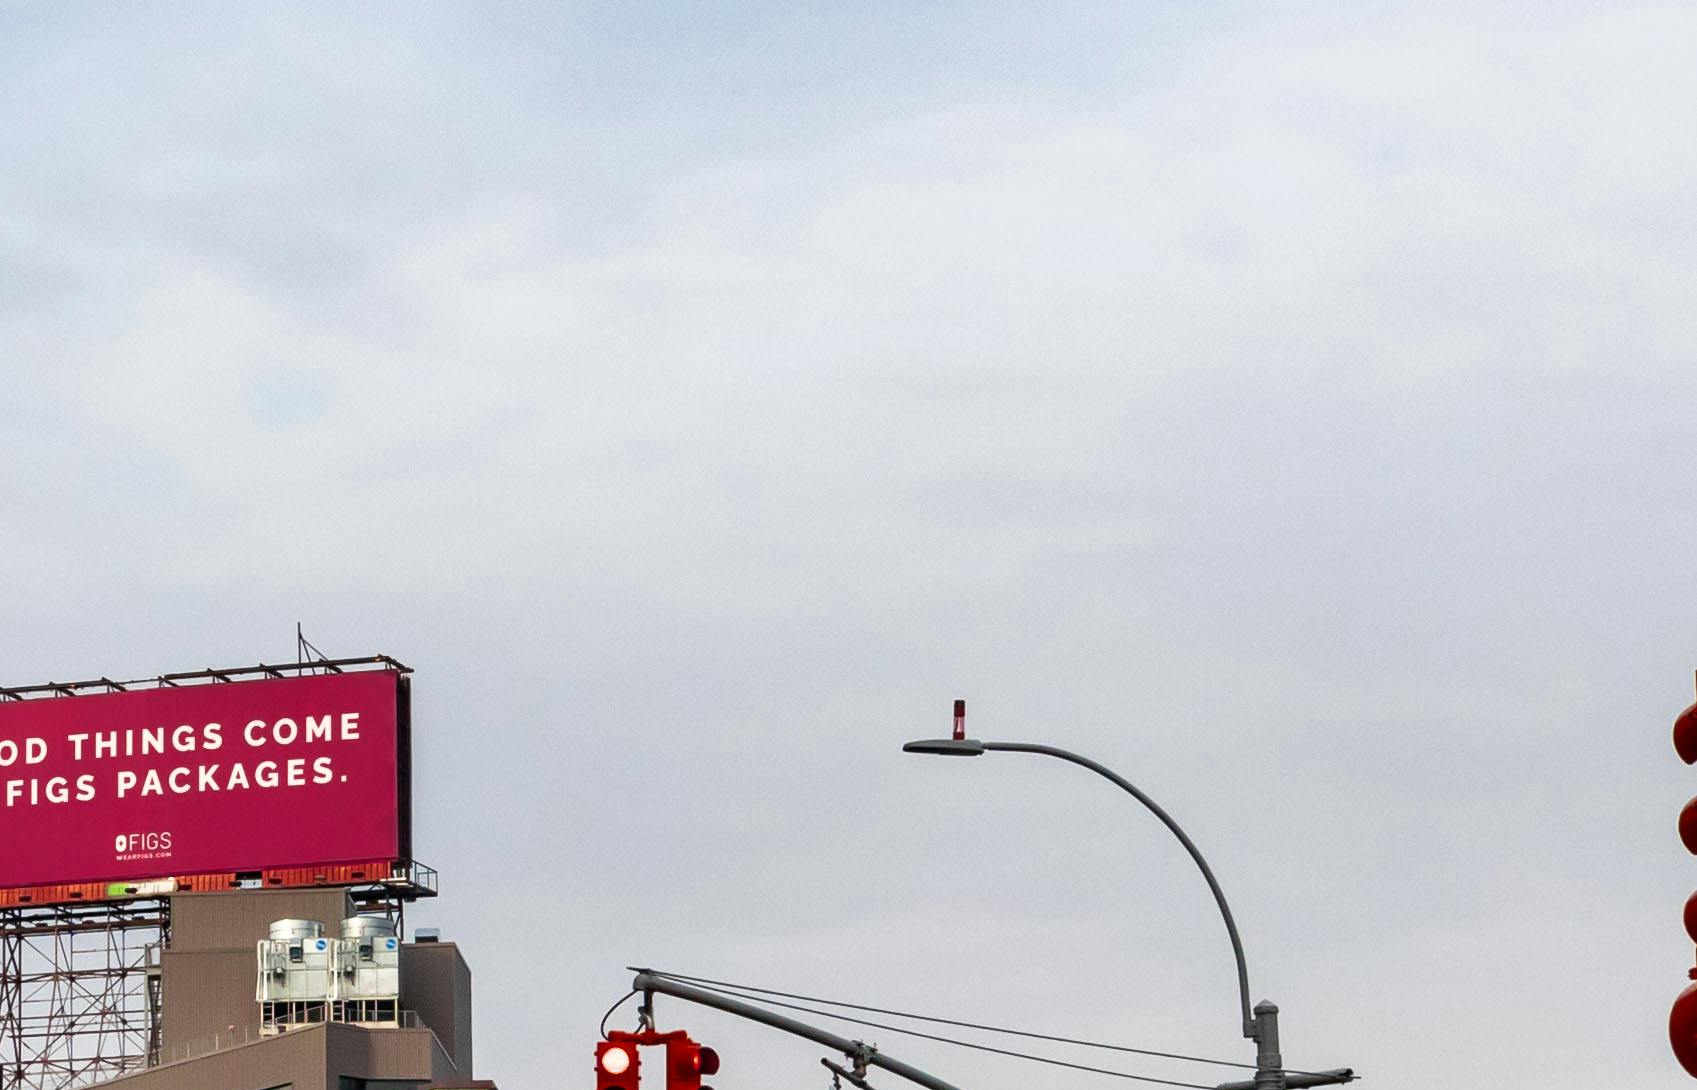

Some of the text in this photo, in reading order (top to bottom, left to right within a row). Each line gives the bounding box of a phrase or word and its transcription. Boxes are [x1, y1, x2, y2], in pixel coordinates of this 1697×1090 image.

[67, 722, 223, 761] THINGS
[243, 712, 360, 747] COME
[6, 774, 96, 807] FIGS
[117, 756, 348, 798] PACKAGES.
[129, 831, 172, 851] FIGS
